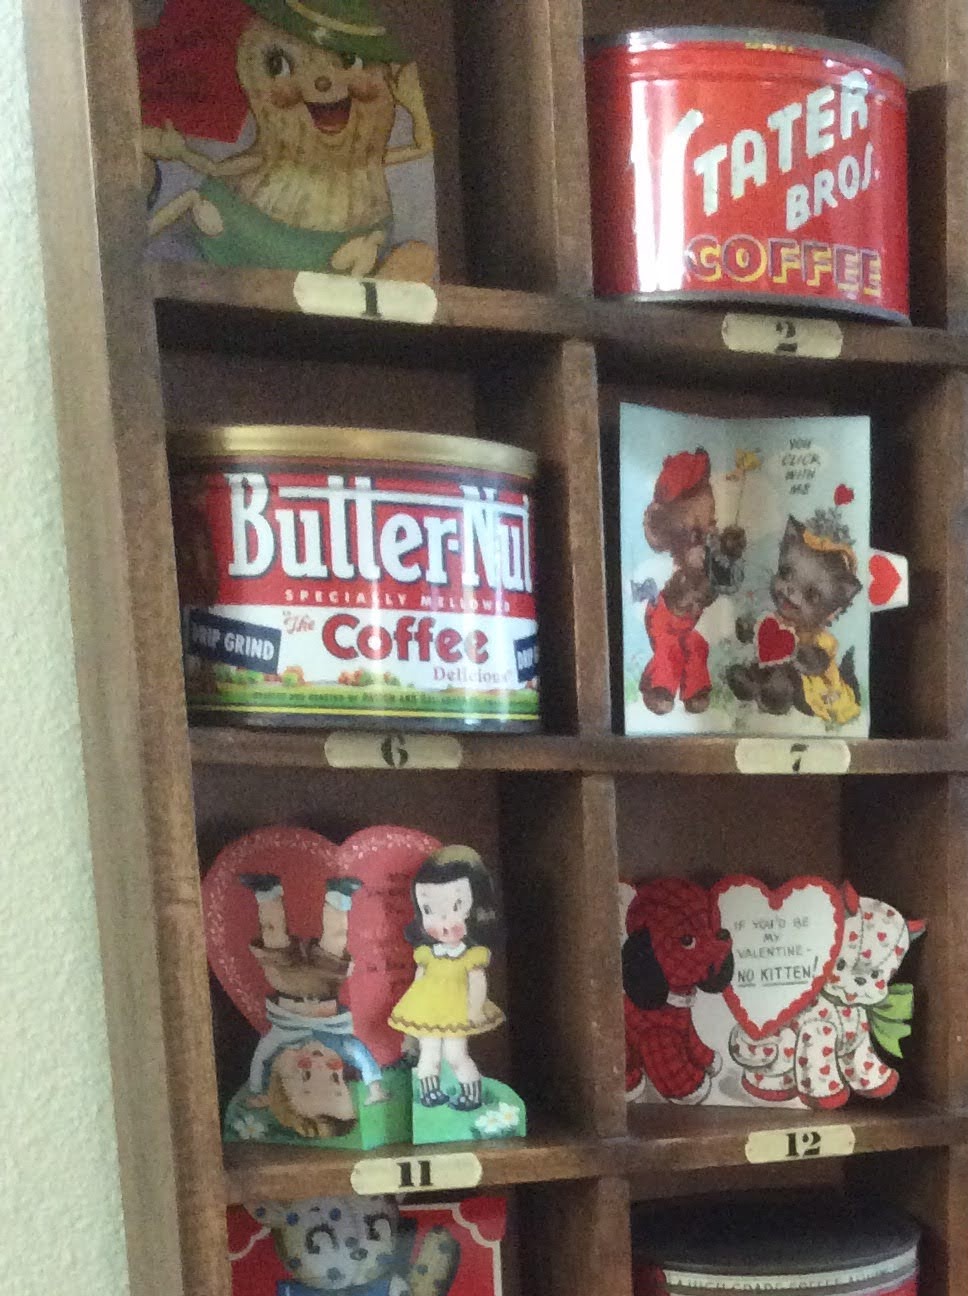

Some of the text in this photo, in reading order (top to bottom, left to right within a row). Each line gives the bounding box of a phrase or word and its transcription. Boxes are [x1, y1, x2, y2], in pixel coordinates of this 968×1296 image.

[652, 70, 869, 228] TATER
[687, 234, 882, 298] COFFEE
[360, 281, 381, 316] 1
[776, 322, 798, 352] 2
[285, 588, 407, 606] SPECIALLY
[224, 632, 276, 661] GRIND
[321, 613, 490, 664] Coffee
[381, 736, 408, 767] 6
[790, 743, 808, 772] 7
[734, 920, 746, 931] IF
[793, 916, 809, 928] BE
[763, 934, 780, 944] MY
[737, 956, 818, 984] NO KITTEN!
[785, 1131, 821, 1157] 12
[397, 1160, 434, 1188] 11
